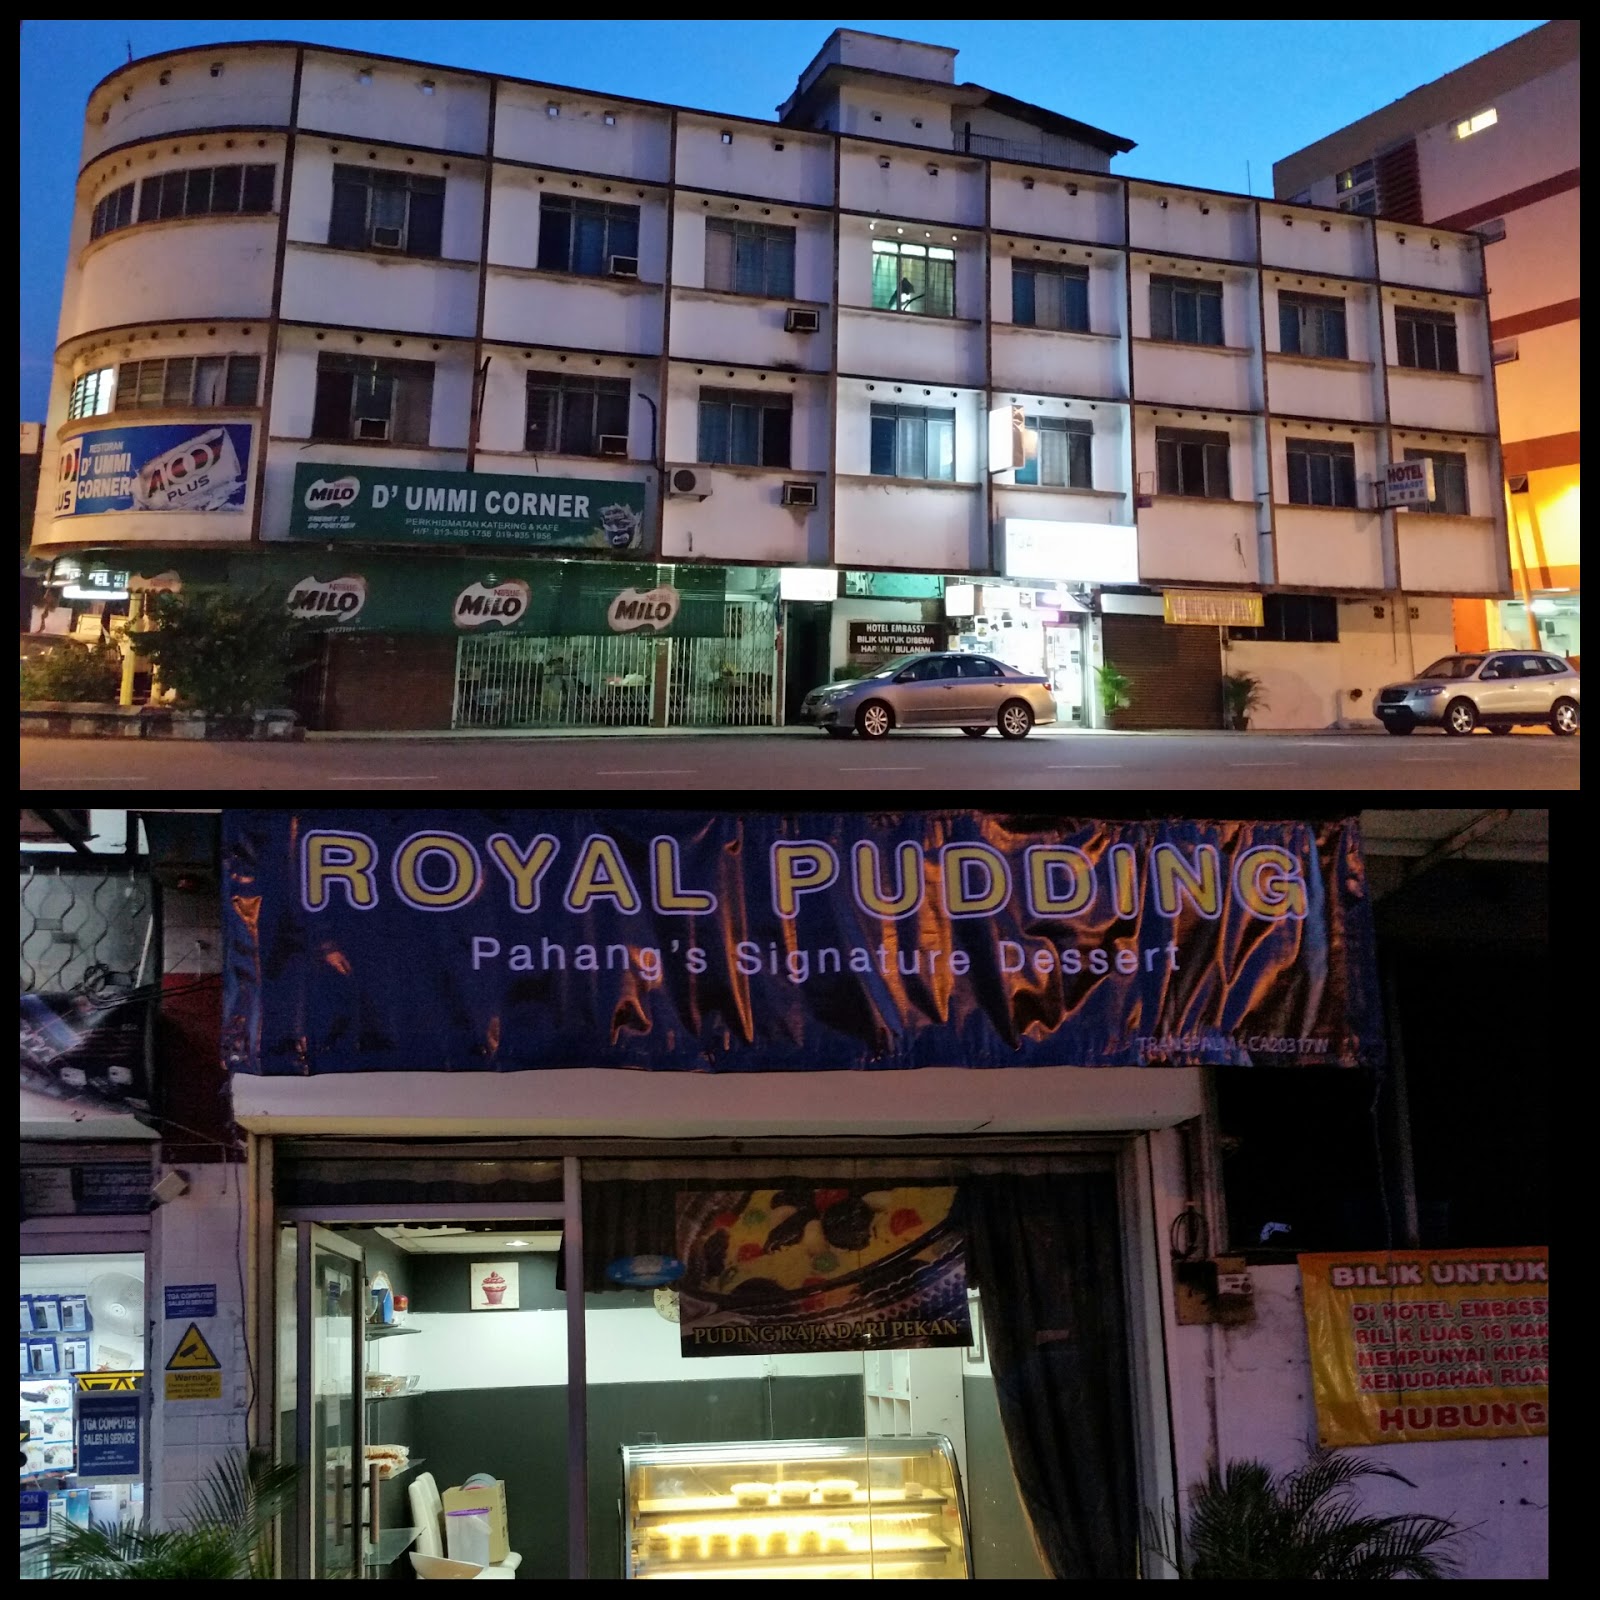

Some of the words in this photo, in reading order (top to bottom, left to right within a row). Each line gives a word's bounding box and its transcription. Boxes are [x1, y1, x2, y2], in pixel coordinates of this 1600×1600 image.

[81, 457, 92, 476] D'
[94, 452, 131, 475] UMMI
[1387, 465, 1423, 482] HOTEL
[78, 477, 131, 499] CORNER
[168, 473, 211, 501] PLUS
[309, 488, 355, 501] MILO
[372, 485, 398, 509] D'
[405, 486, 477, 513] UMMI
[484, 490, 590, 518] CORNER
[405, 518, 479, 528] PERKHIDMATAN
[481, 521, 527, 531] KATERING
[529, 523, 534, 531] &
[536, 523, 560, 532] KAFE
[289, 589, 359, 612] MILO
[458, 595, 522, 616] MILO
[615, 600, 671, 620] MILO
[866, 623, 889, 632] HOTEL
[891, 624, 925, 633] EMBASSY
[857, 635, 877, 643] BILIK
[878, 635, 904, 644] UNTUK
[906, 636, 935, 645] DISEWA
[895, 646, 930, 654] BULANAN
[301, 829, 718, 915] ROYAL
[770, 838, 1309, 922] PUDDING
[471, 936, 707, 981] Pahang's
[735, 940, 972, 984] Signature
[999, 939, 1181, 976] Dessert
[1333, 1264, 1422, 1286] BILIK
[1431, 1262, 1549, 1283] UNTUK
[1353, 1306, 1375, 1321] DI
[1383, 1304, 1454, 1320] HOTEL
[1461, 1300, 1549, 1318] EMBASS
[694, 1326, 776, 1344] PUDING
[782, 1323, 834, 1345] RAJA
[836, 1320, 886, 1339] DARI
[891, 1318, 959, 1336] PEKAN
[1419, 1325, 1475, 1342] LUAS
[1480, 1324, 1504, 1340] 16
[1358, 1348, 1486, 1367] MEMPUNYAI
[175, 1373, 213, 1382] Warning
[1361, 1368, 1494, 1389] KEMUDAHAN
[1501, 1366, 1549, 1384] RUA
[83, 1418, 97, 1431] TGA
[98, 1416, 136, 1430] COMPUTER
[83, 1433, 103, 1446] SALES
[110, 1432, 135, 1445] SERVICE
